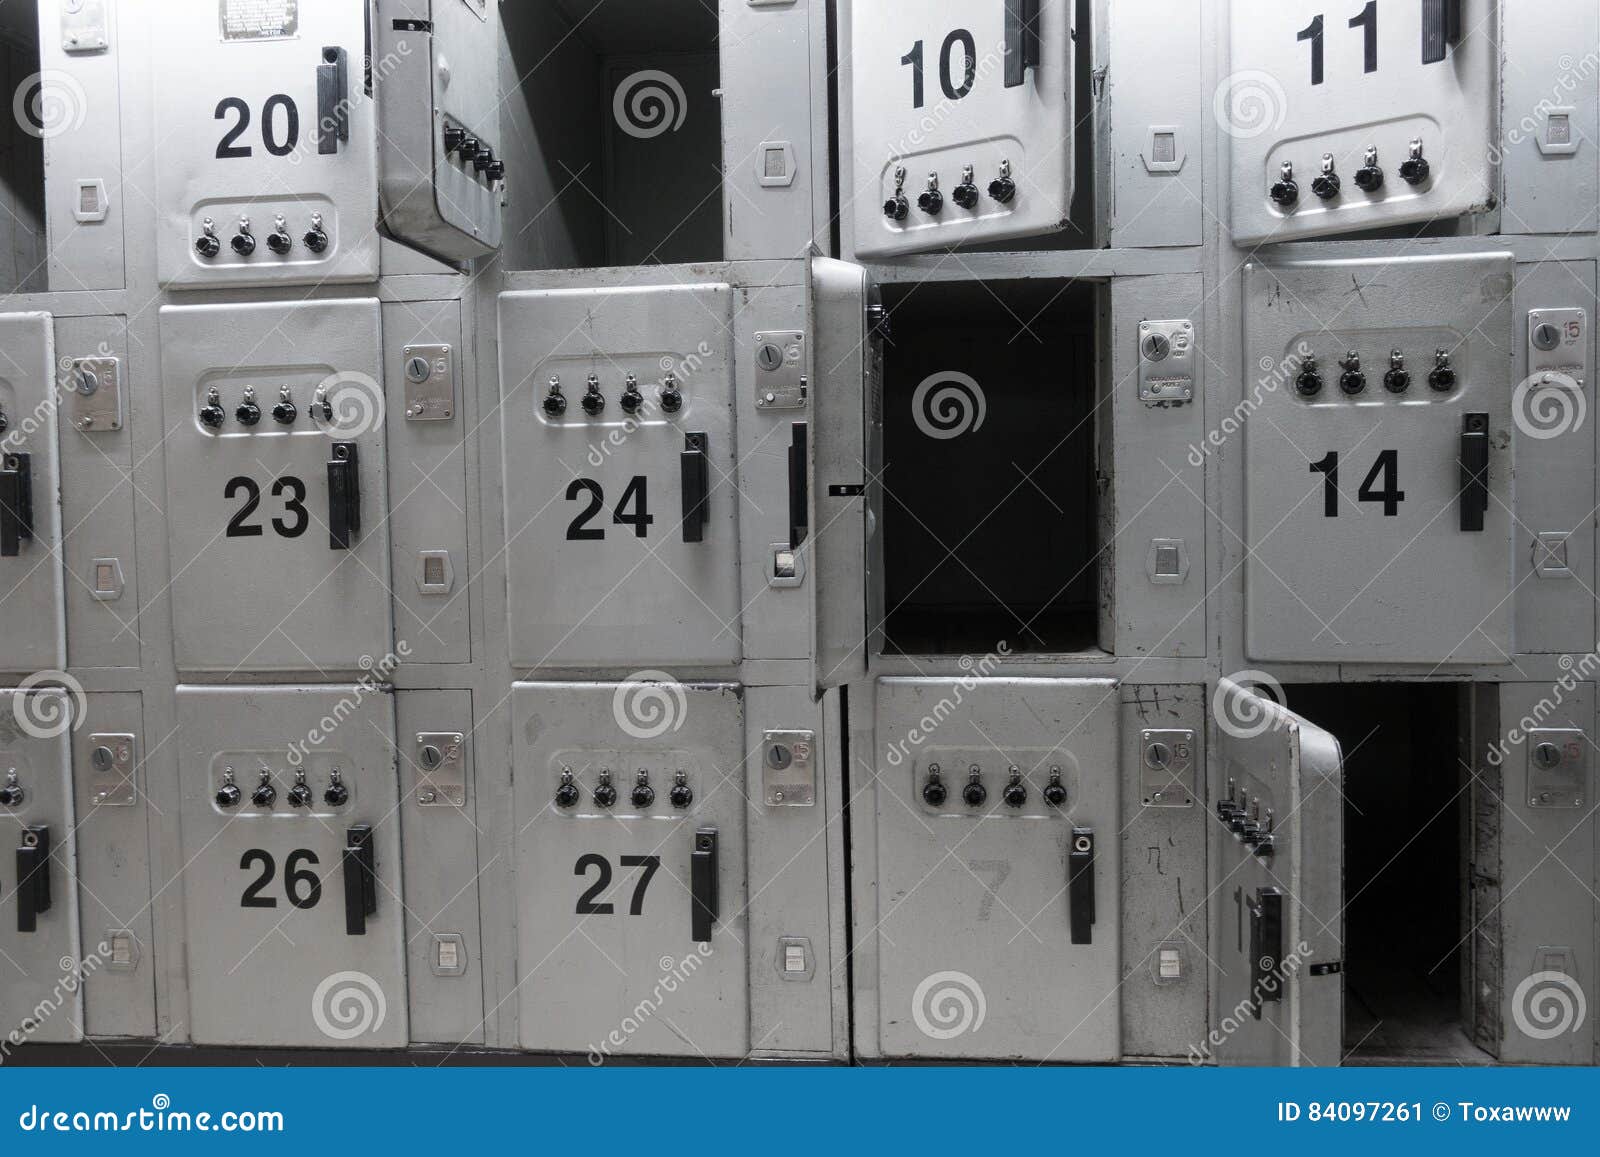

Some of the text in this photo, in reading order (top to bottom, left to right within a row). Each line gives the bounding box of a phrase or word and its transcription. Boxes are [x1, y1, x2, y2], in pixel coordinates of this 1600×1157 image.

[901, 28, 977, 109] 10
[1296, 0, 1377, 85] 11
[214, 94, 299, 159] 20
[224, 475, 310, 539] 23
[566, 475, 654, 541] 24
[1309, 449, 1406, 518] 14
[240, 848, 322, 910] 26
[574, 853, 661, 916] 27
